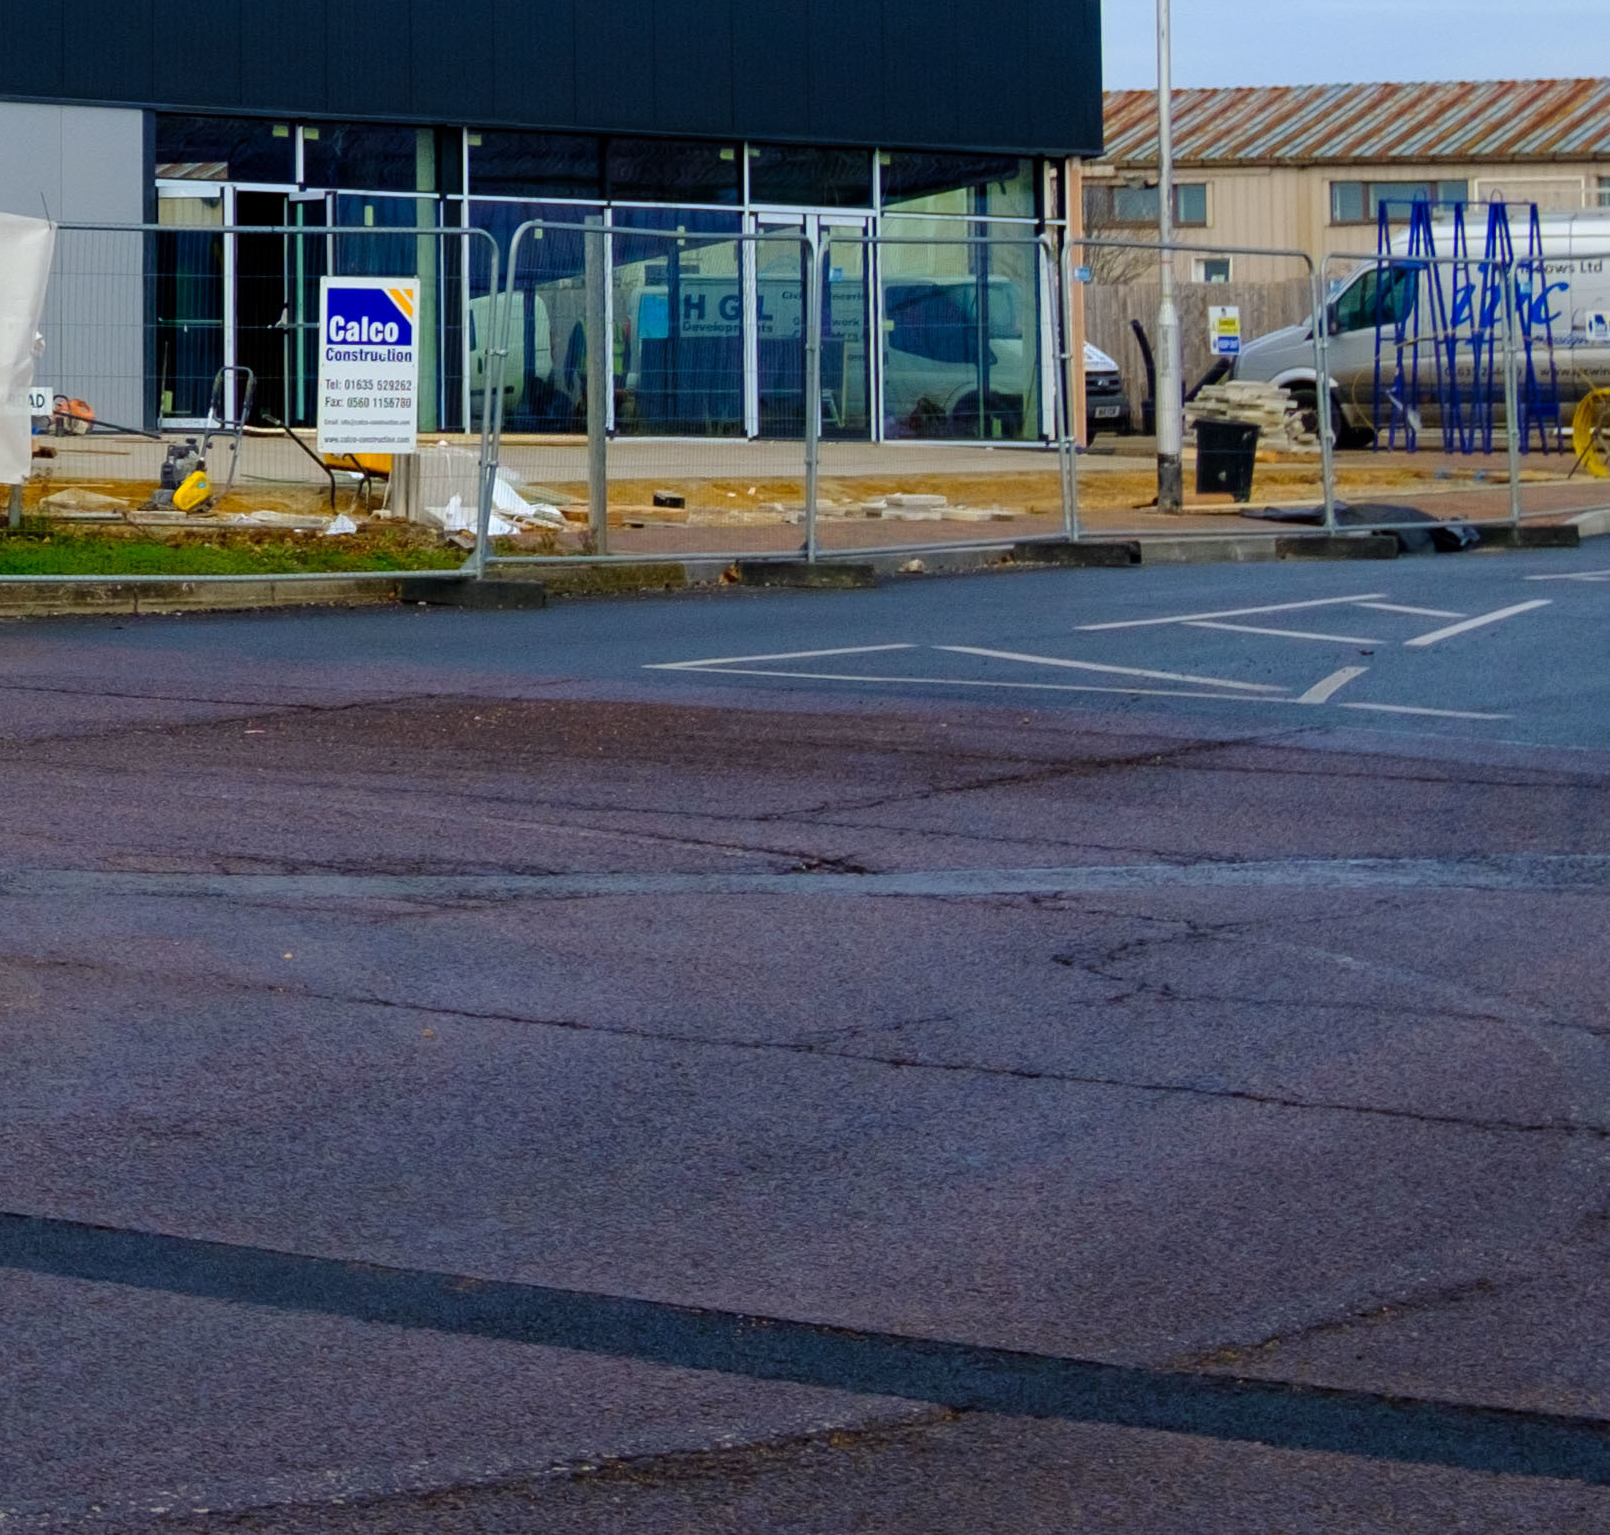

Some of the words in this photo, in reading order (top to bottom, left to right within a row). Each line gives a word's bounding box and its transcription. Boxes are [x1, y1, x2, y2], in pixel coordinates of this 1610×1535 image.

[1580, 260, 1603, 273] Ltd
[329, 315, 399, 343] Calco
[326, 347, 412, 363] Construction
[325, 379, 341, 390] Tel:
[344, 379, 374, 390] 01635
[325, 397, 343, 407] Fax:
[347, 397, 370, 408] 0560
